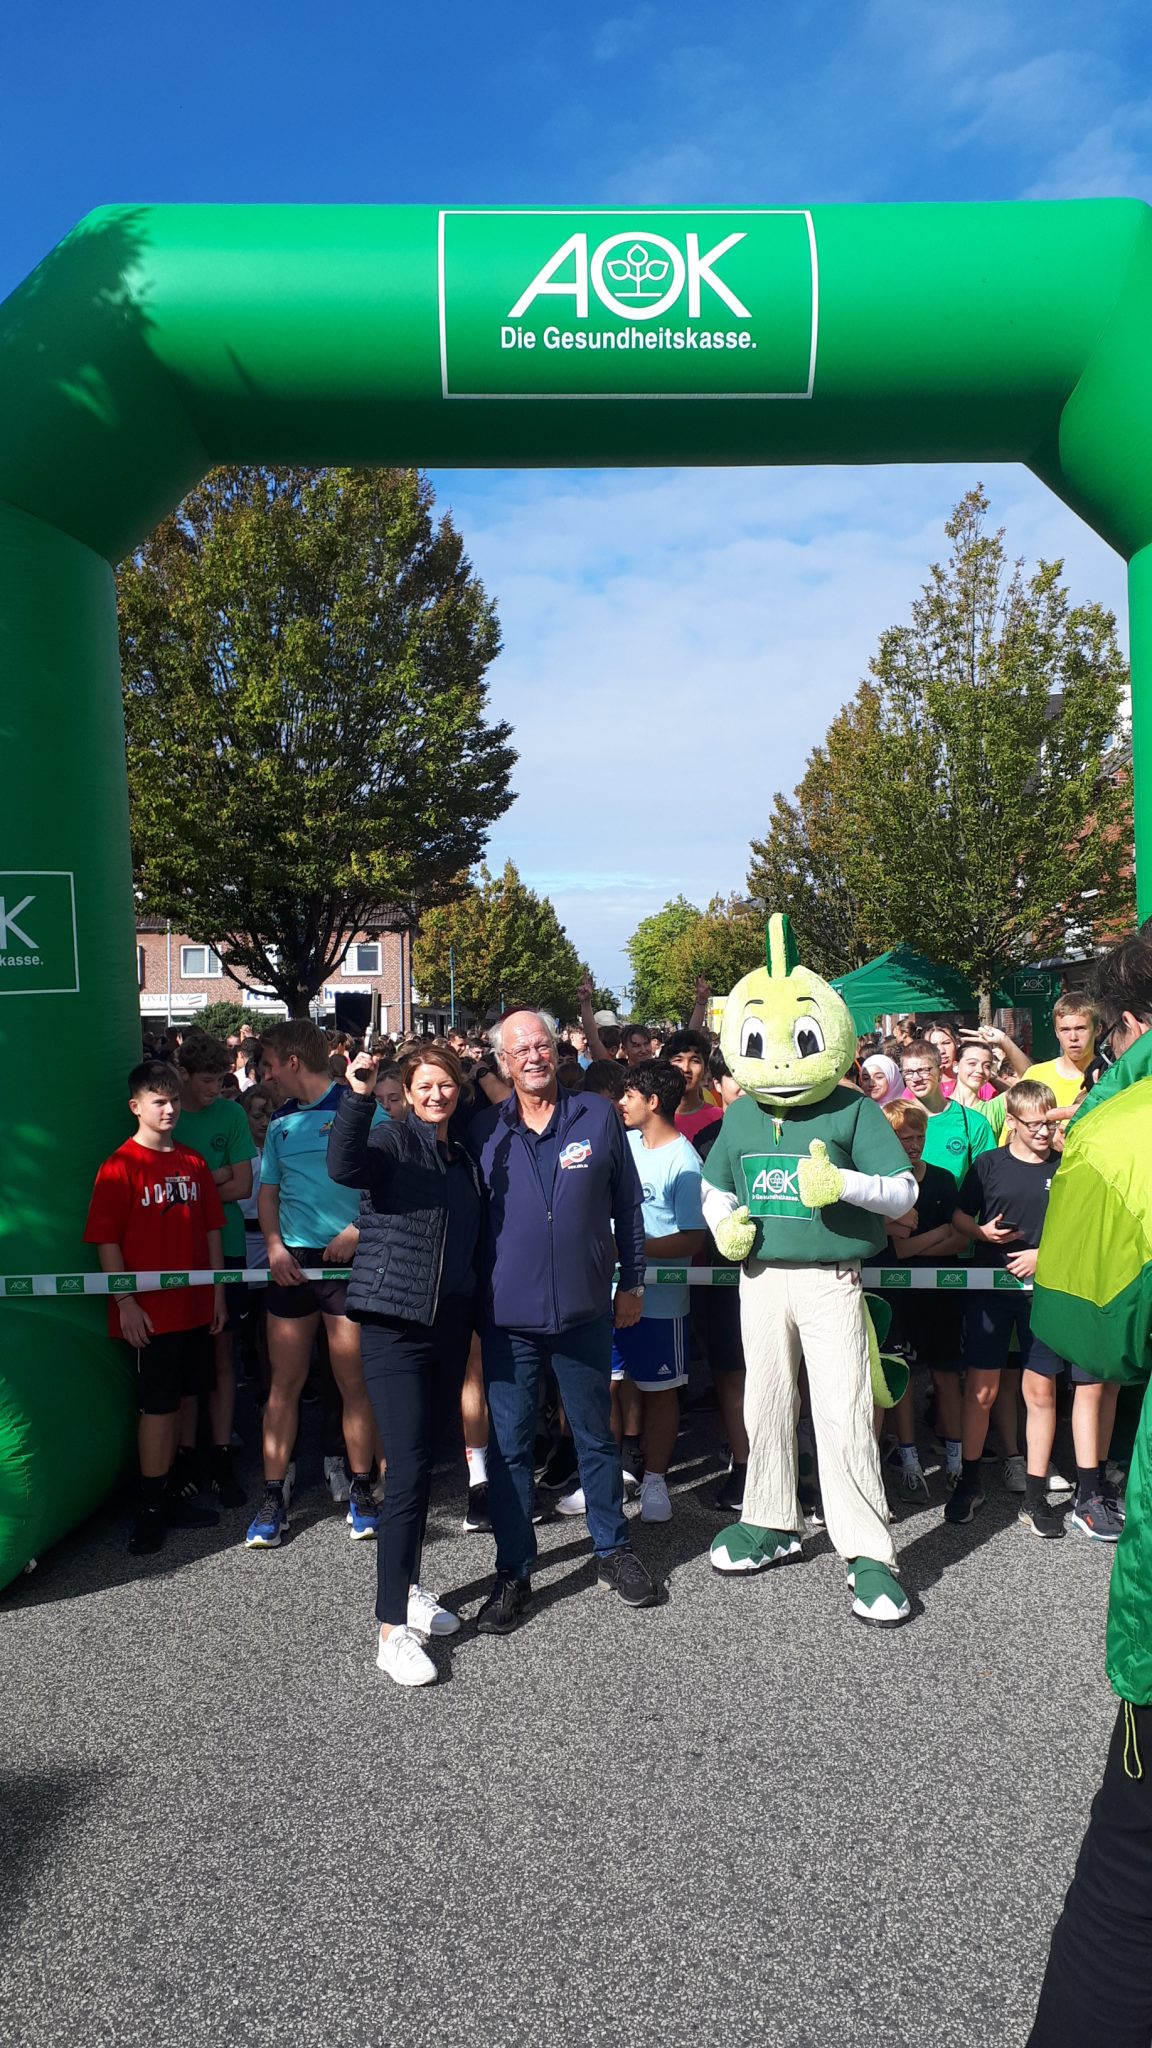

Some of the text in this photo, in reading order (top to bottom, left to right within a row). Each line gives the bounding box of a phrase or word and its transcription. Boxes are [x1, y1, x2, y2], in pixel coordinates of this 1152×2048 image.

[506, 231, 753, 320] AOK
[501, 326, 758, 349] Die Gesundheitskasse.
[752, 1169, 799, 1194] AOK
[141, 1181, 200, 1207] JORDA
[167, 1276, 184, 1285] AOK
[664, 1273, 682, 1281] AOK
[718, 1272, 738, 1281] AOK
[888, 1273, 906, 1282] AOK
[944, 1273, 962, 1282] AOK
[11, 1281, 28, 1289] AOK
[62, 1280, 80, 1288] AOK
[113, 1278, 131, 1286] AOK
